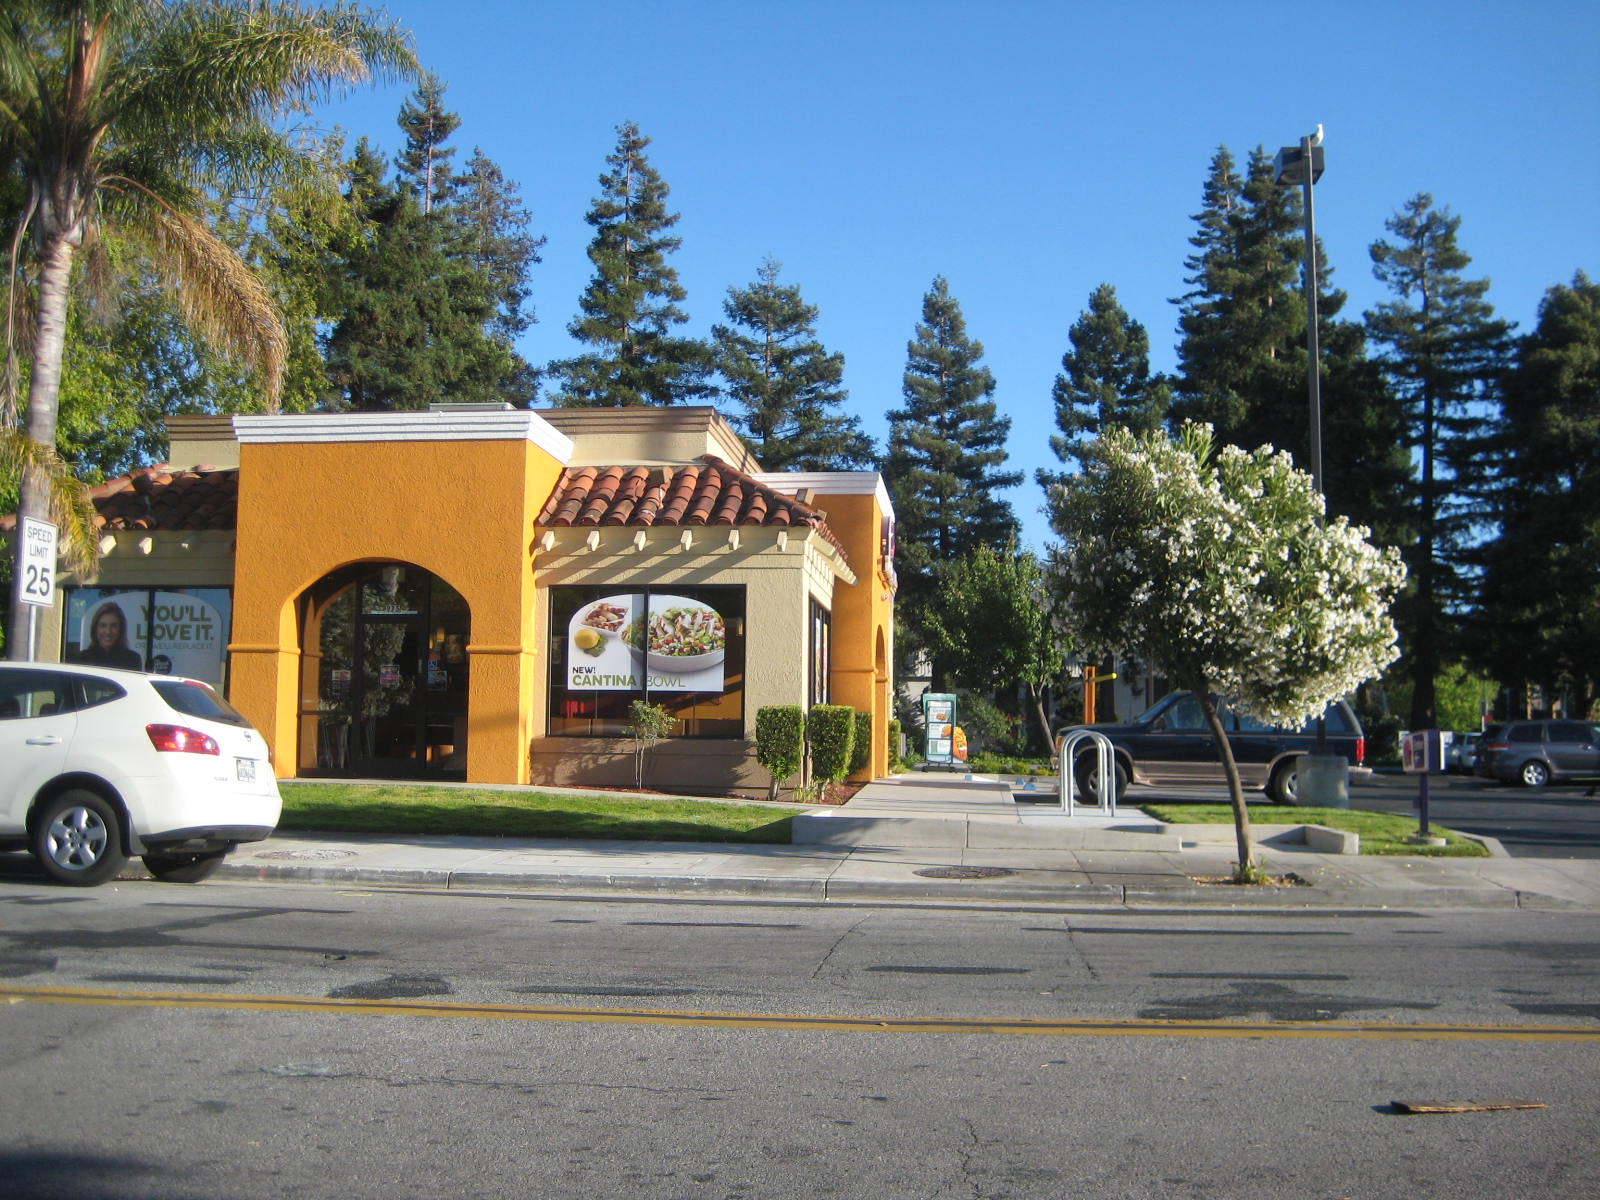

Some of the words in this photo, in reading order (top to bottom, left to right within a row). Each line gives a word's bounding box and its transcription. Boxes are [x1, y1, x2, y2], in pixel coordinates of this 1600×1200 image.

[27, 526, 53, 543] SPEED
[29, 544, 49, 559] LIMIT
[26, 564, 50, 597] 25
[140, 605, 211, 622] YOU'LL
[136, 624, 192, 640] LOVE
[195, 624, 214, 640] IT.
[572, 666, 596, 674] NEW!
[572, 675, 636, 686] CANTINA
[641, 676, 686, 687] BOWL
